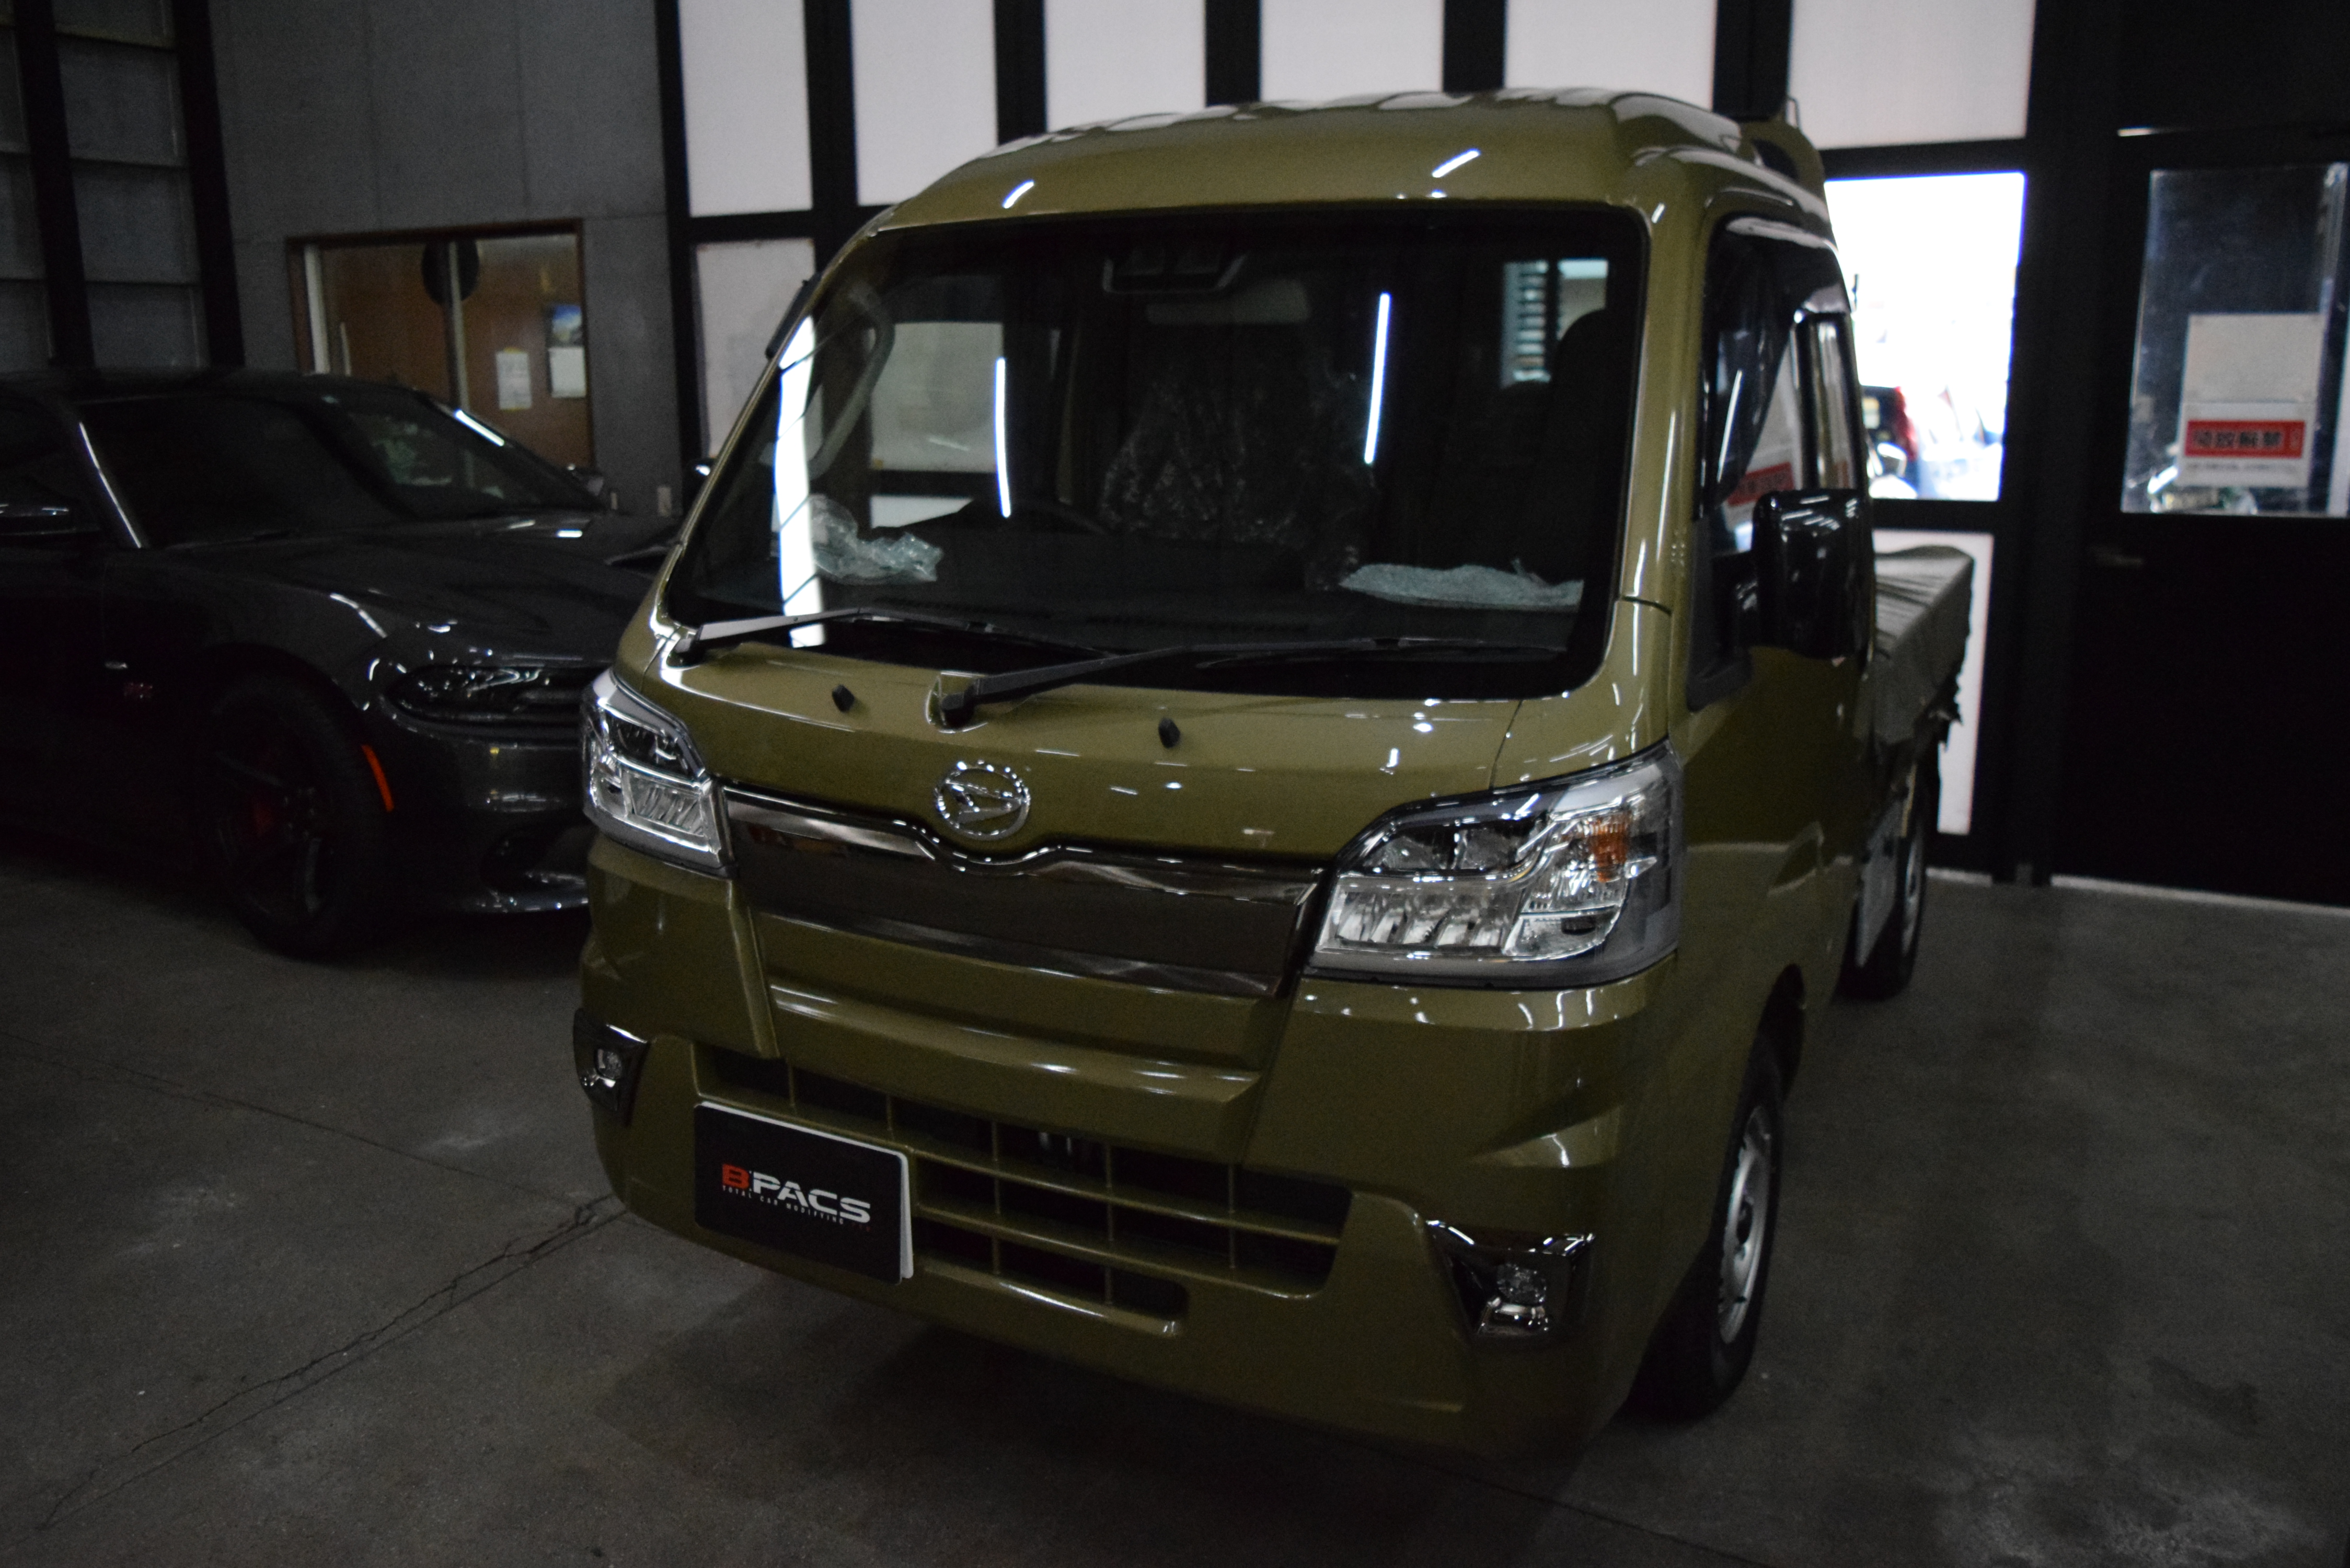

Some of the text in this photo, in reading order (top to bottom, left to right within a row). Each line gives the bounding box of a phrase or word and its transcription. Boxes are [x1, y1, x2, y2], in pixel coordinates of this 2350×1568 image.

[722, 1185, 844, 1225] TOTAL CAR MODIFYING
